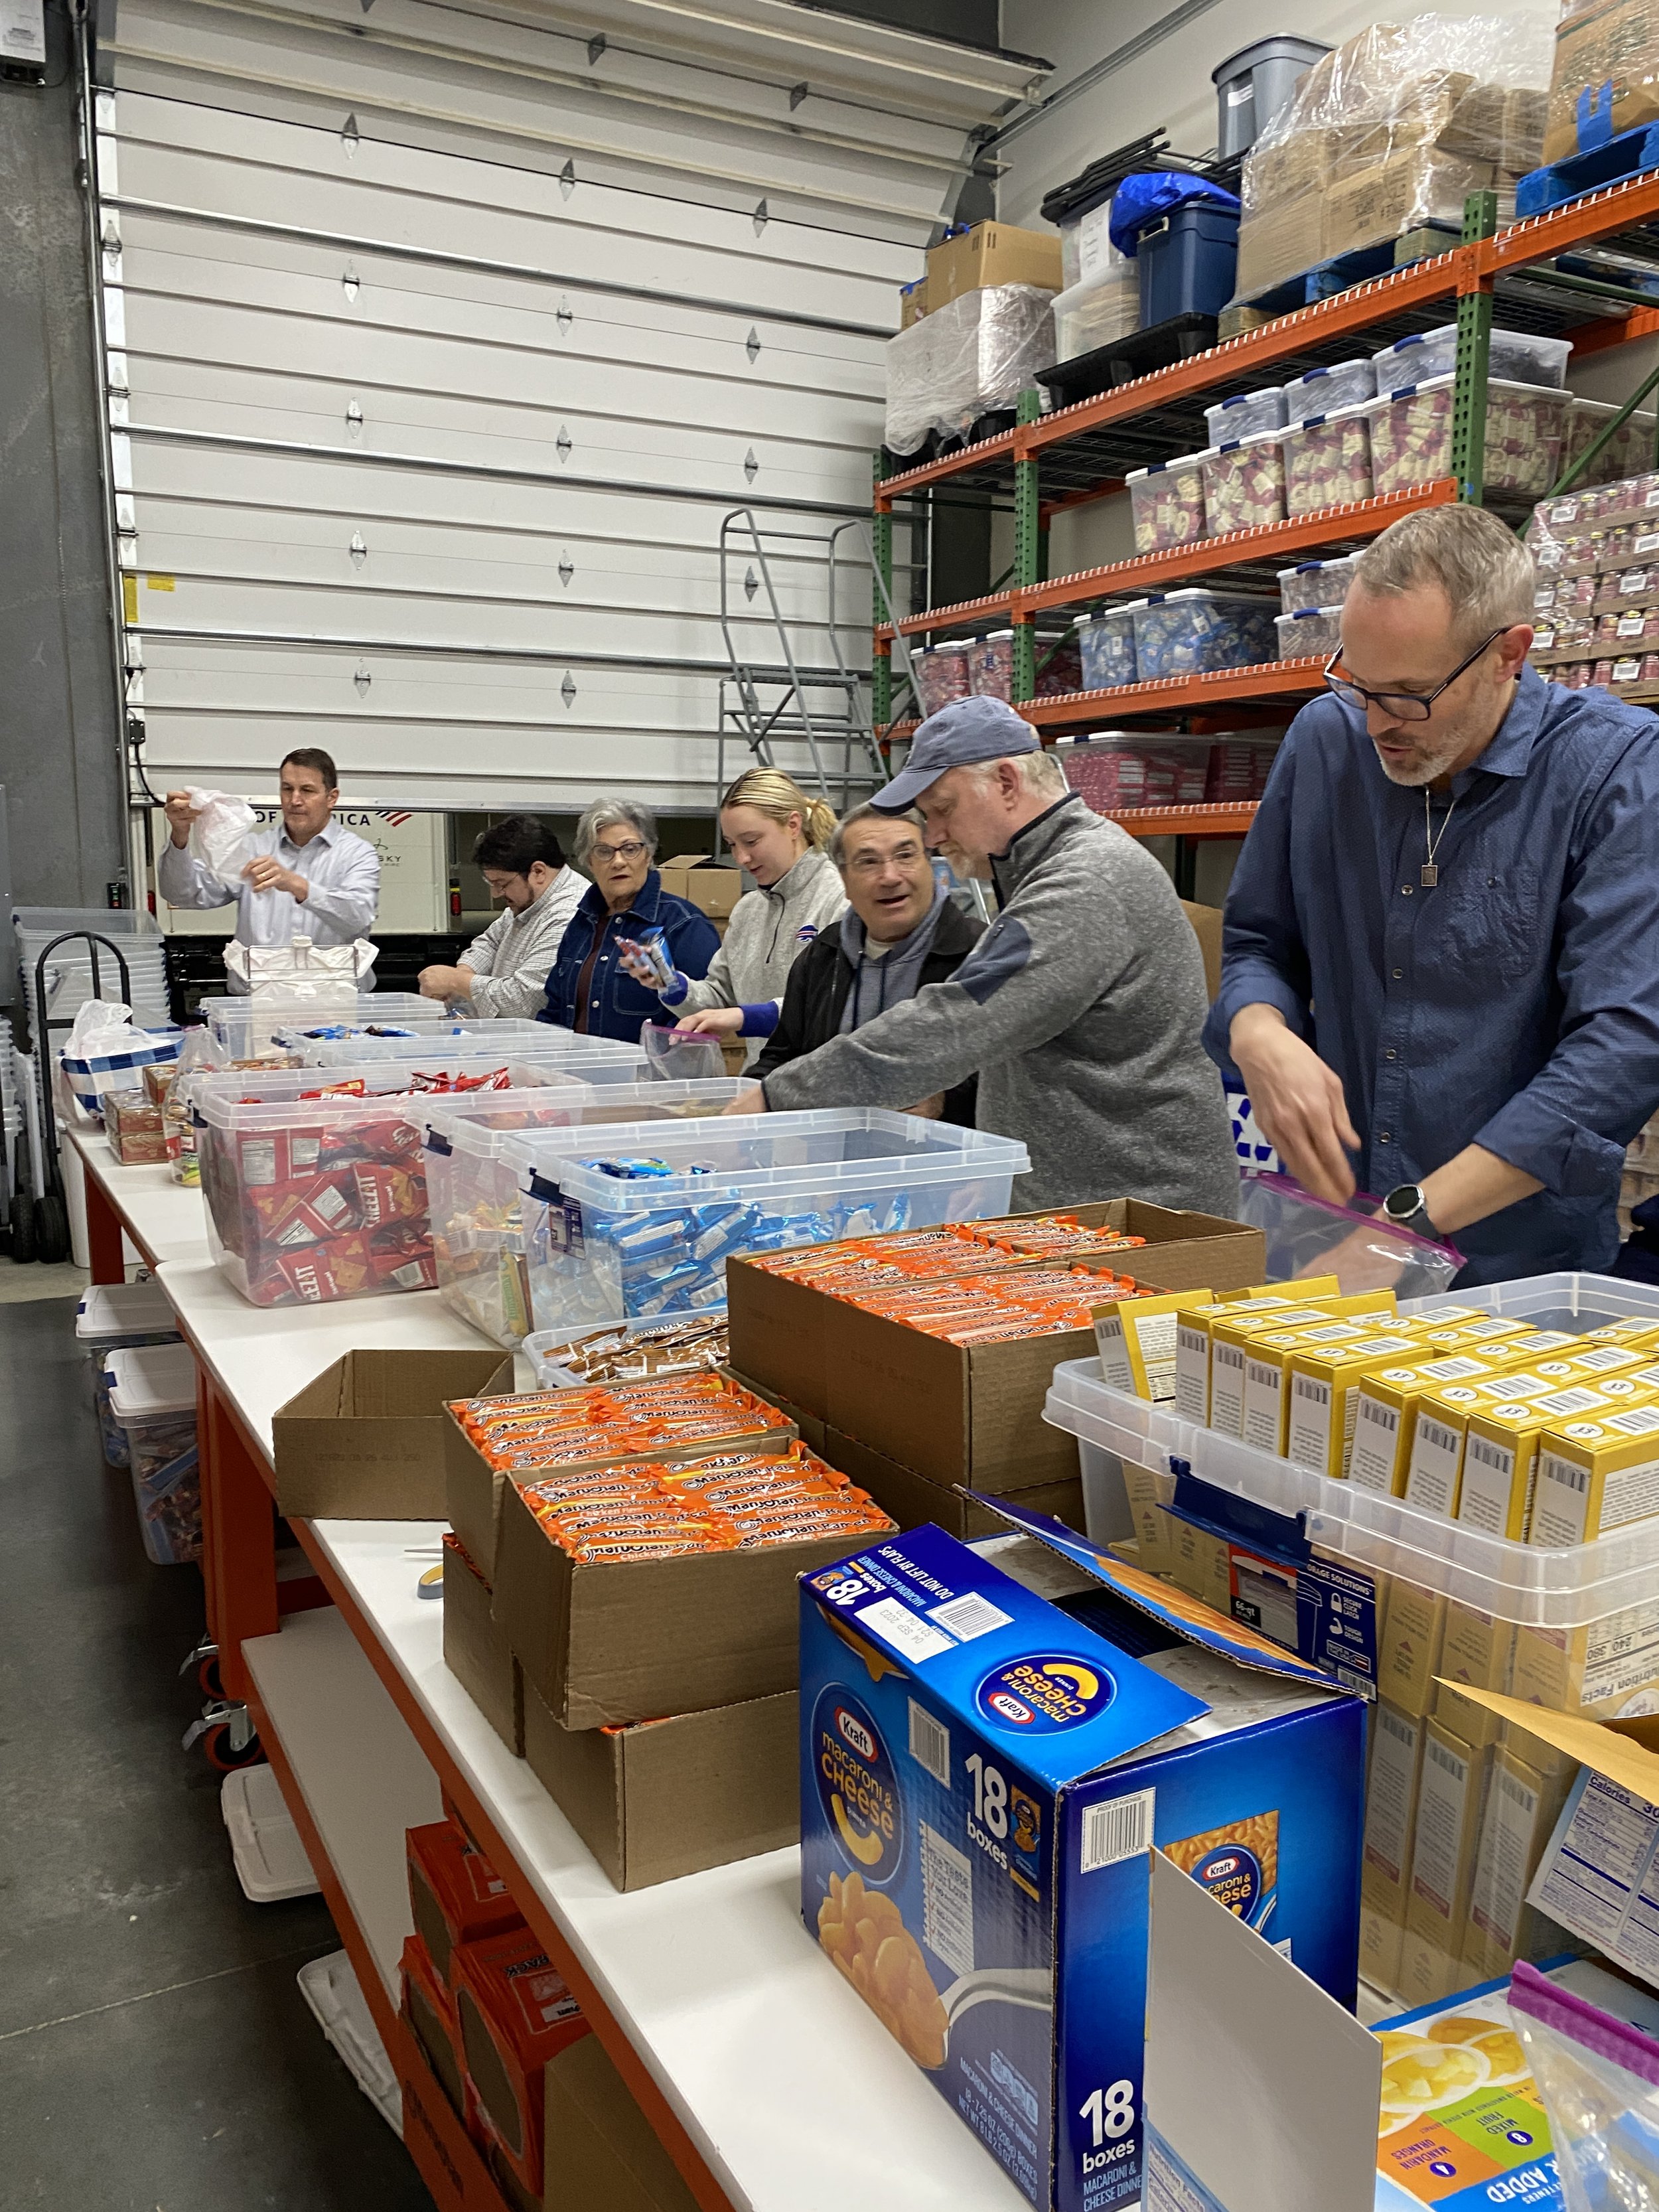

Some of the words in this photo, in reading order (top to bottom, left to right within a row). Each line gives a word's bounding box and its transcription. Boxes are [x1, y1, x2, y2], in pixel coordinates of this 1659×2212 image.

[695, 1467, 762, 1484] Maruchan
[717, 1481, 788, 1497] Maruchan
[727, 1497, 800, 1512] Maruchan
[749, 1510, 821, 1524] Maruchan
[743, 1524, 819, 1543] Maruchan
[821, 1518, 872, 1530] Ramen
[857, 1556, 881, 1572] DINNER
[878, 1546, 906, 1564] FLAPS
[897, 1561, 915, 1571] BY
[904, 1567, 929, 1581] LIFT
[859, 1573, 887, 1593] boxes
[873, 1568, 899, 1584] CHEESE
[919, 1578, 944, 1591] NOT
[826, 1579, 870, 1605] 18
[893, 1585, 927, 1607] MACARONI
[934, 1587, 954, 1600] DO
[880, 1609, 900, 1624] 2023
[897, 1625, 913, 1635] SEP
[1001, 1672, 1015, 1682] &
[1007, 1678, 1071, 1723] macaroni
[1581, 1684, 1615, 1703] Facts
[999, 1698, 1027, 1718] Kraft
[843, 1716, 868, 1753] Kraft
[822, 1731, 883, 1803] macaroni
[884, 1791, 893, 1812] &
[964, 1753, 1007, 1840] 18
[1590, 1776, 1631, 1805] Calories
[967, 1811, 1007, 1870] boxes
[1210, 1862, 1232, 1876] Kraft
[1243, 1873, 1252, 1883] &
[1079, 2079, 1135, 2147] 18
[1475, 2111, 1504, 2126] FRUIT
[1486, 2118, 1520, 2135] MIXED
[1082, 2138, 1135, 2174] boxes
[1391, 2138, 1436, 2161] ORANGES
[1399, 2146, 1452, 2171] MANDARIN
[1433, 2163, 1450, 2175] 4
[1083, 2166, 1128, 2196] MACARONI
[1128, 2161, 1137, 2175] &
[1486, 2167, 1548, 2203] ADDED
[1083, 2185, 1117, 2212] CHEESE
[1117, 2174, 1143, 2197] DINNE
